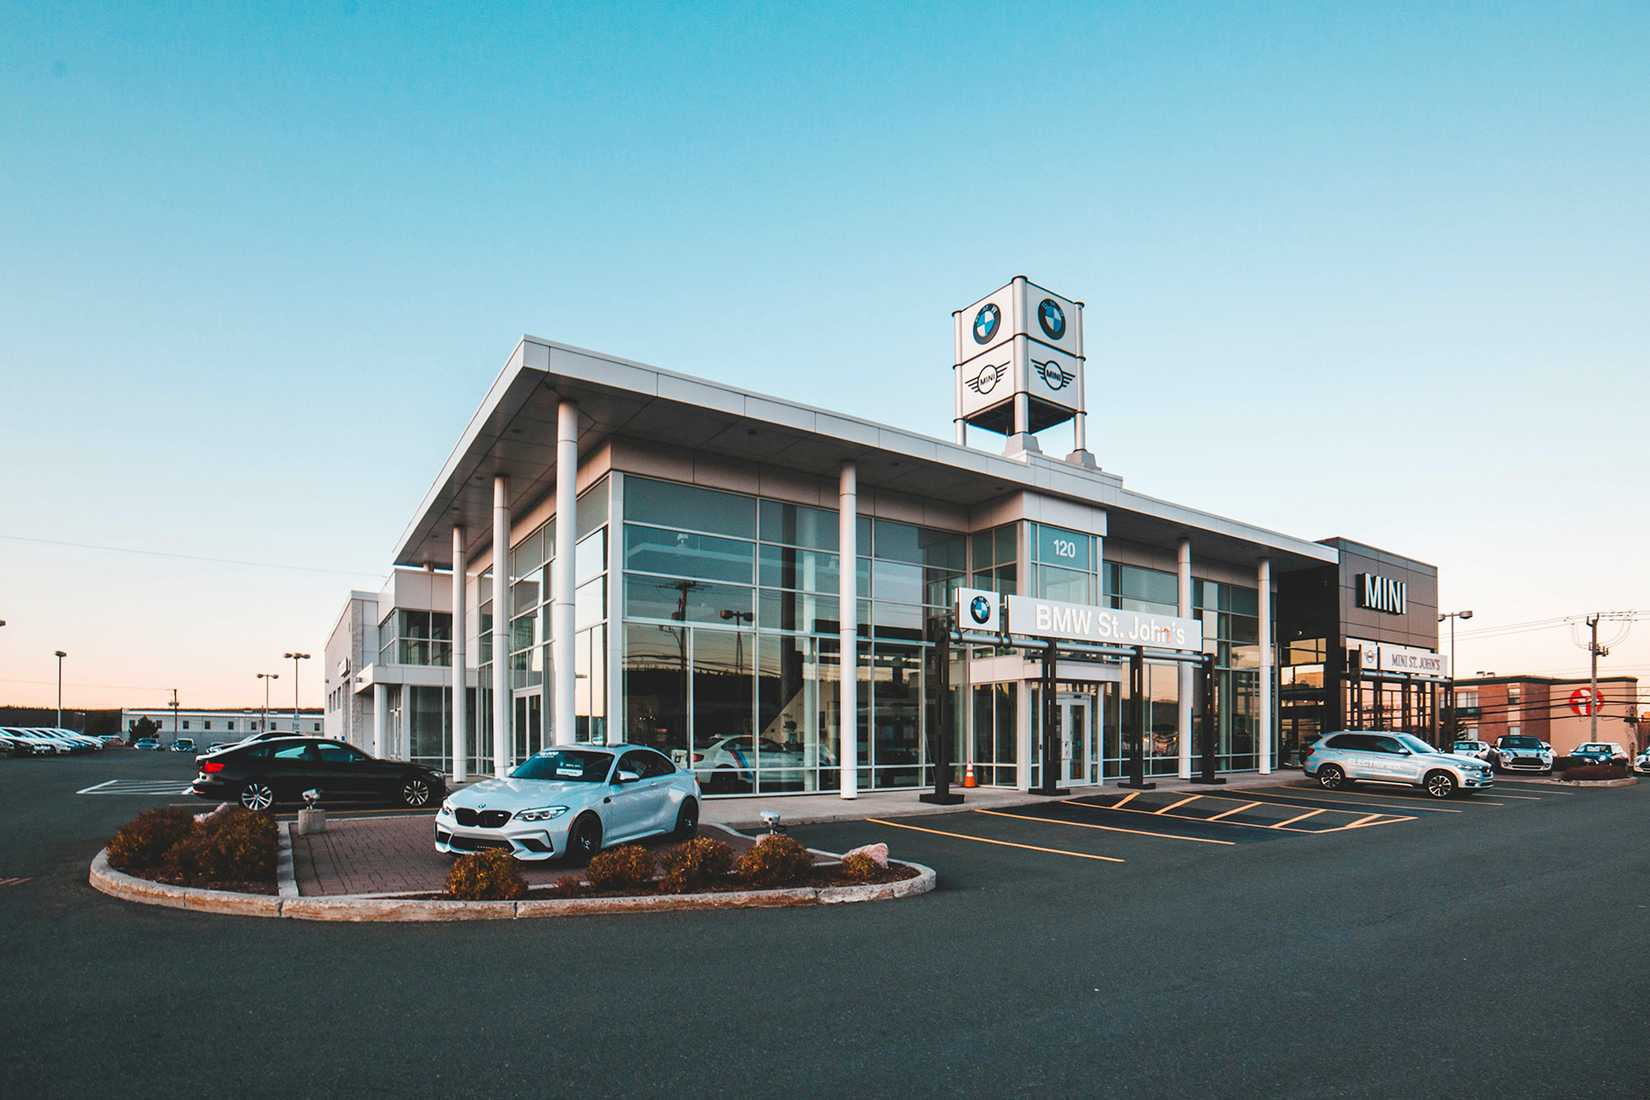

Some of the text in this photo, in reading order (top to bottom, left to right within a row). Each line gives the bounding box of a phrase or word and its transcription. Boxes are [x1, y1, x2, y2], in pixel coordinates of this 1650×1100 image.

[1053, 539, 1076, 559] 120
[1364, 572, 1407, 615] MINI
[1036, 604, 1185, 644] BMW St. John's
[1391, 654, 1408, 668] MINI
